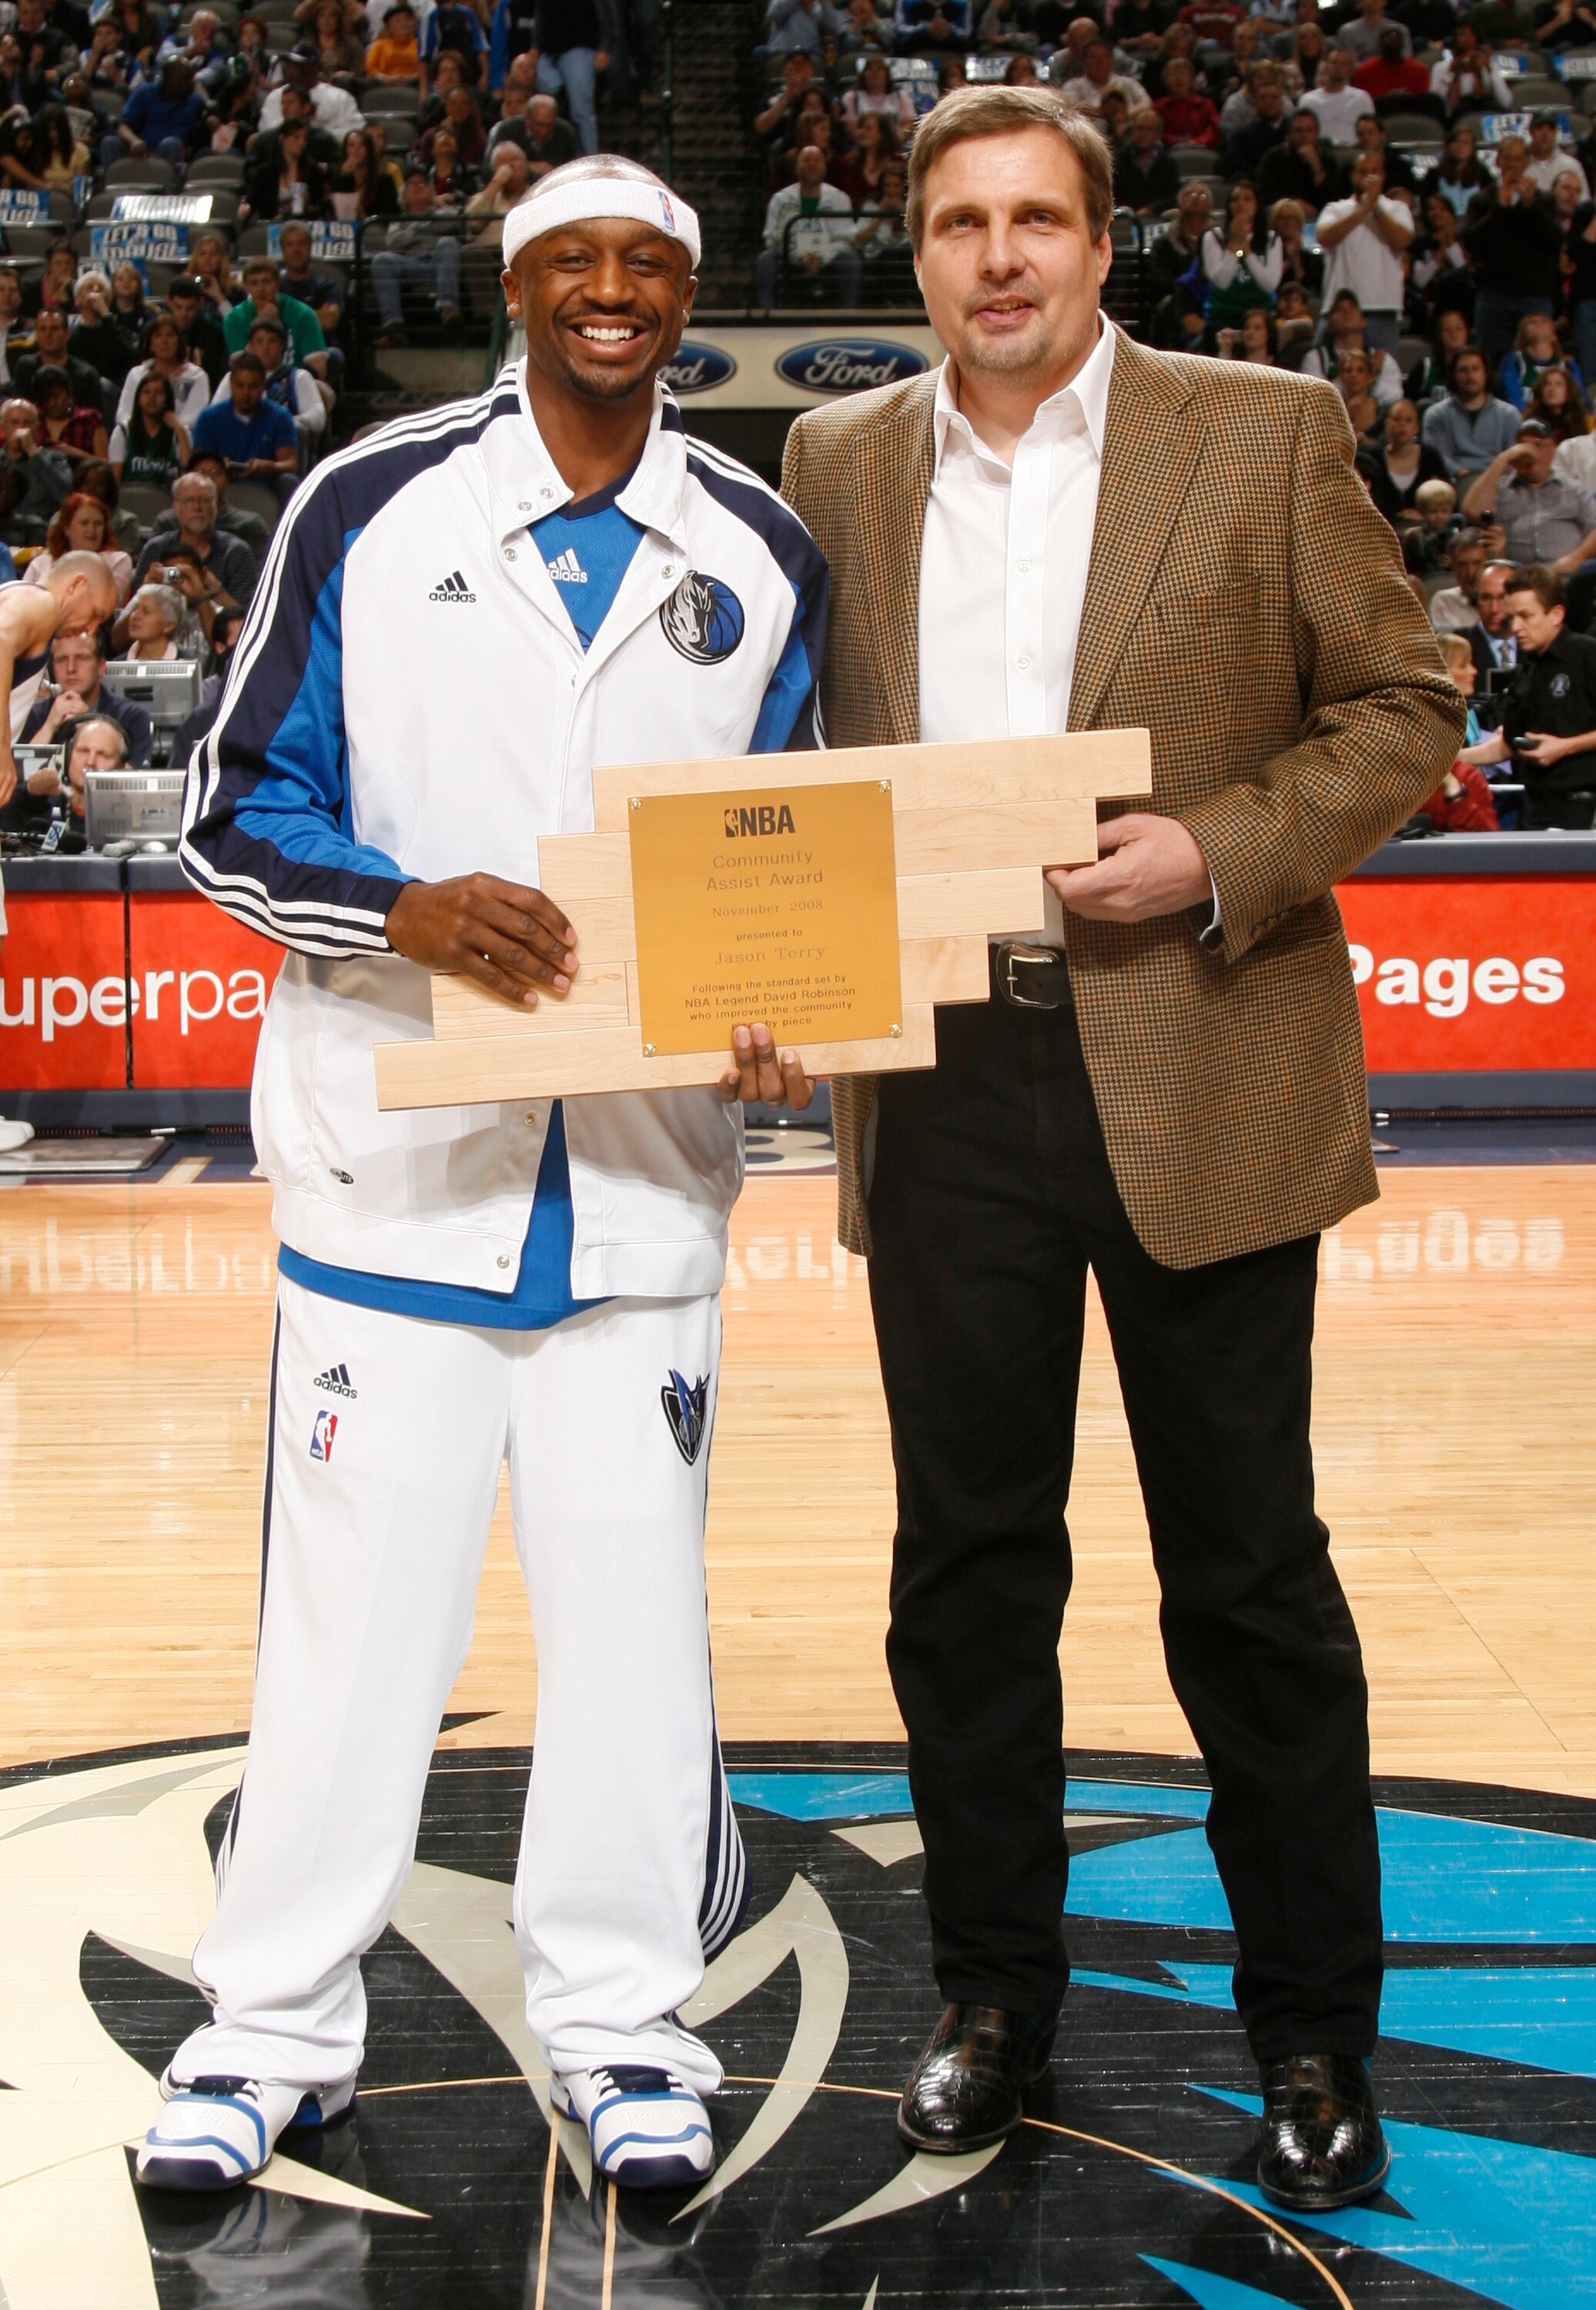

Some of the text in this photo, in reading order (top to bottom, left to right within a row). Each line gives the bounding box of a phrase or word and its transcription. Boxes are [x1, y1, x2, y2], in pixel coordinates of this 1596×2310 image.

[657, 350, 704, 385] ord
[805, 346, 899, 384] Ford
[547, 567, 588, 583] didas
[429, 591, 477, 603] adidas
[739, 805, 796, 836] NBA
[713, 850, 813, 869] Community
[707, 870, 823, 891] Assist Award
[713, 899, 823, 918] November 2008
[736, 929, 788, 942] presented
[715, 947, 825, 964] Jason Terry
[693, 974, 846, 993] Following the standard set by
[1347, 943, 1565, 1018] Pages
[685, 988, 855, 1008] NBA Legend David Robinson
[690, 1001, 852, 1020] who improved the community
[765, 1016, 812, 1028] by piece
[313, 1378, 357, 1399] adidas
